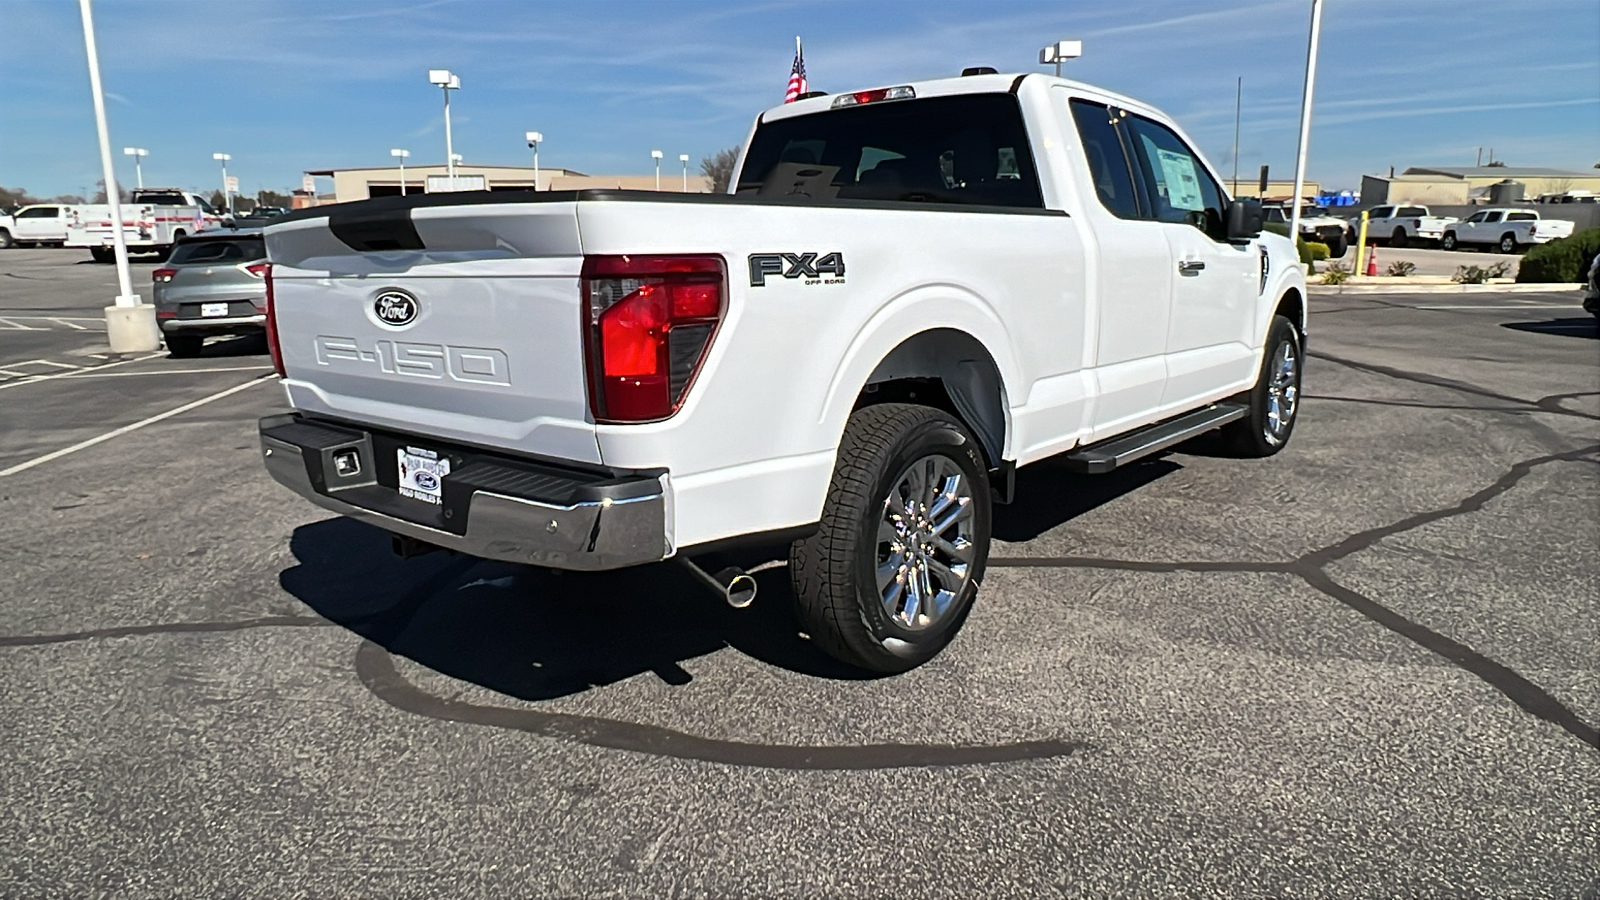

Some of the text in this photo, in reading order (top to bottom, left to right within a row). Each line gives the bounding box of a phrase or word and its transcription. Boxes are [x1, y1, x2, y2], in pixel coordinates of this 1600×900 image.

[747, 252, 846, 287] FX4
[378, 295, 410, 320] Ford
[314, 335, 512, 386] F-150
